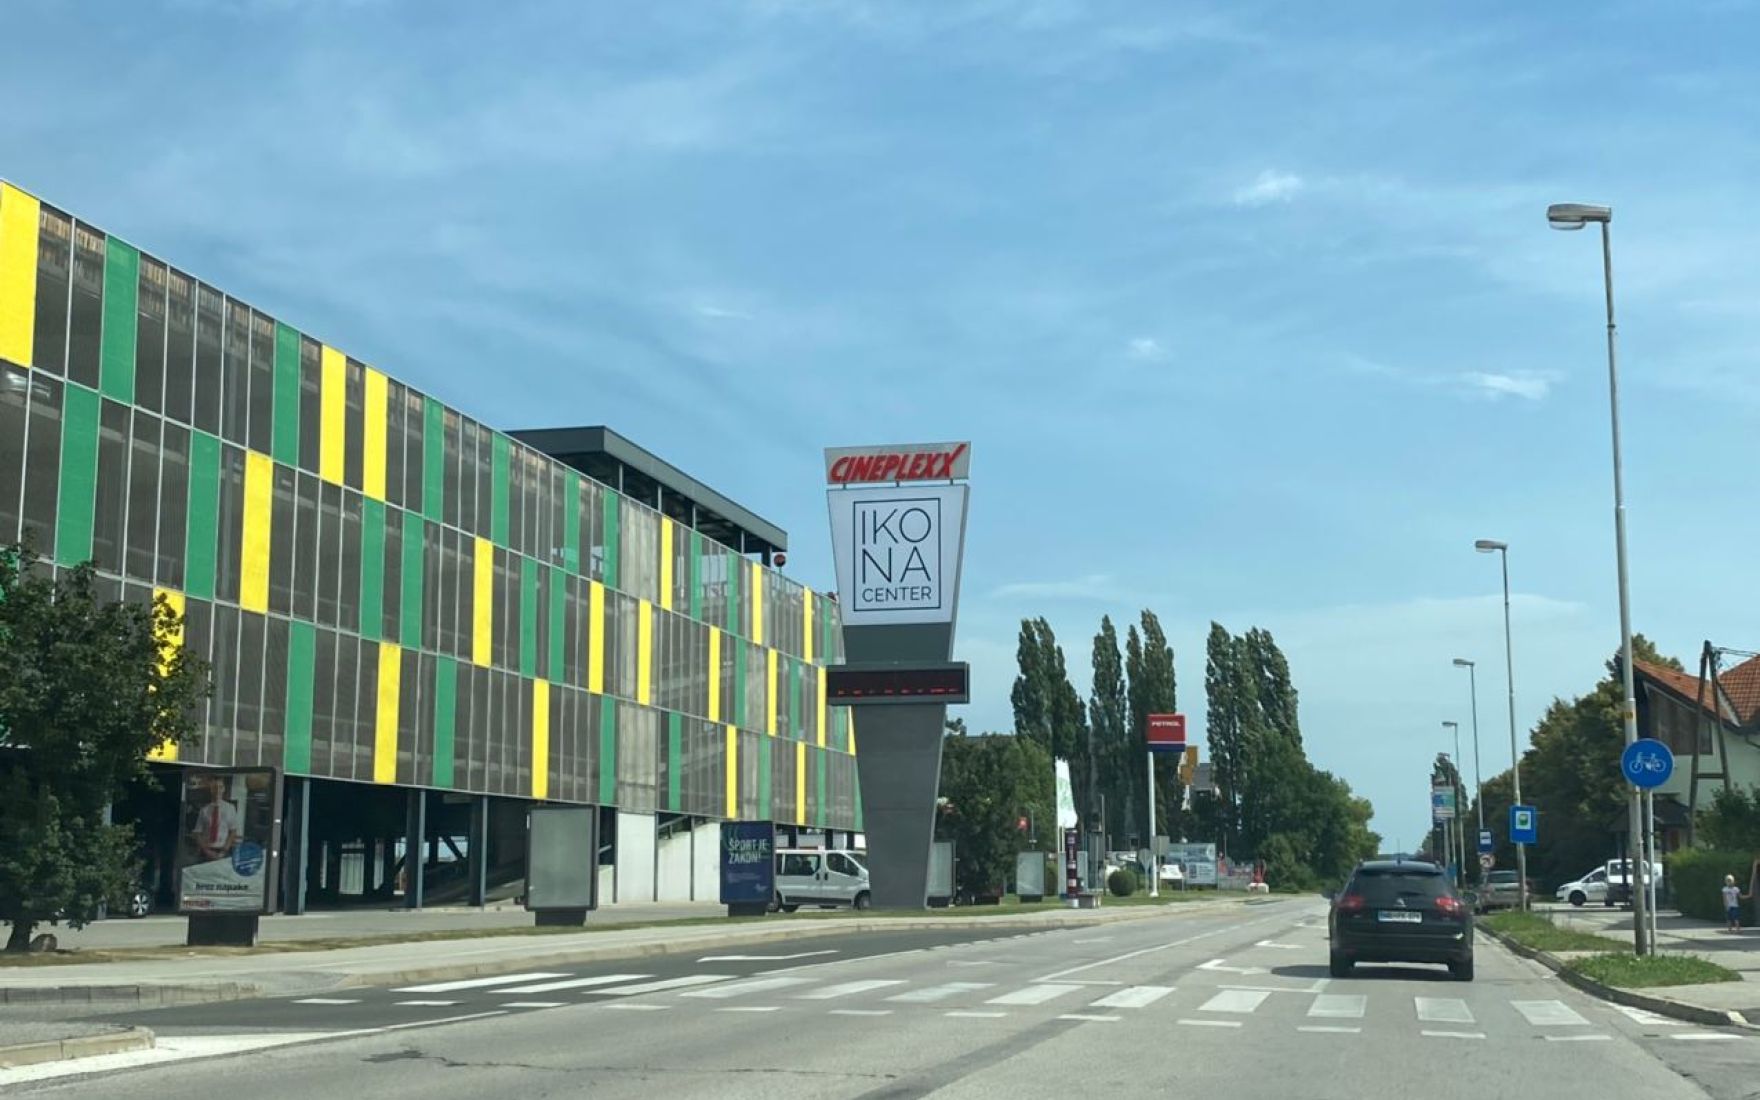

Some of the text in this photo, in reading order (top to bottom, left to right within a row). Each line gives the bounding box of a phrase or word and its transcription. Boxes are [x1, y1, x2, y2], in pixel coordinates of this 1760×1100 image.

[829, 443, 967, 482] CINEPLEXX
[862, 508, 931, 544] IKO
[862, 546, 931, 584] NA
[862, 586, 932, 602] CENTER
